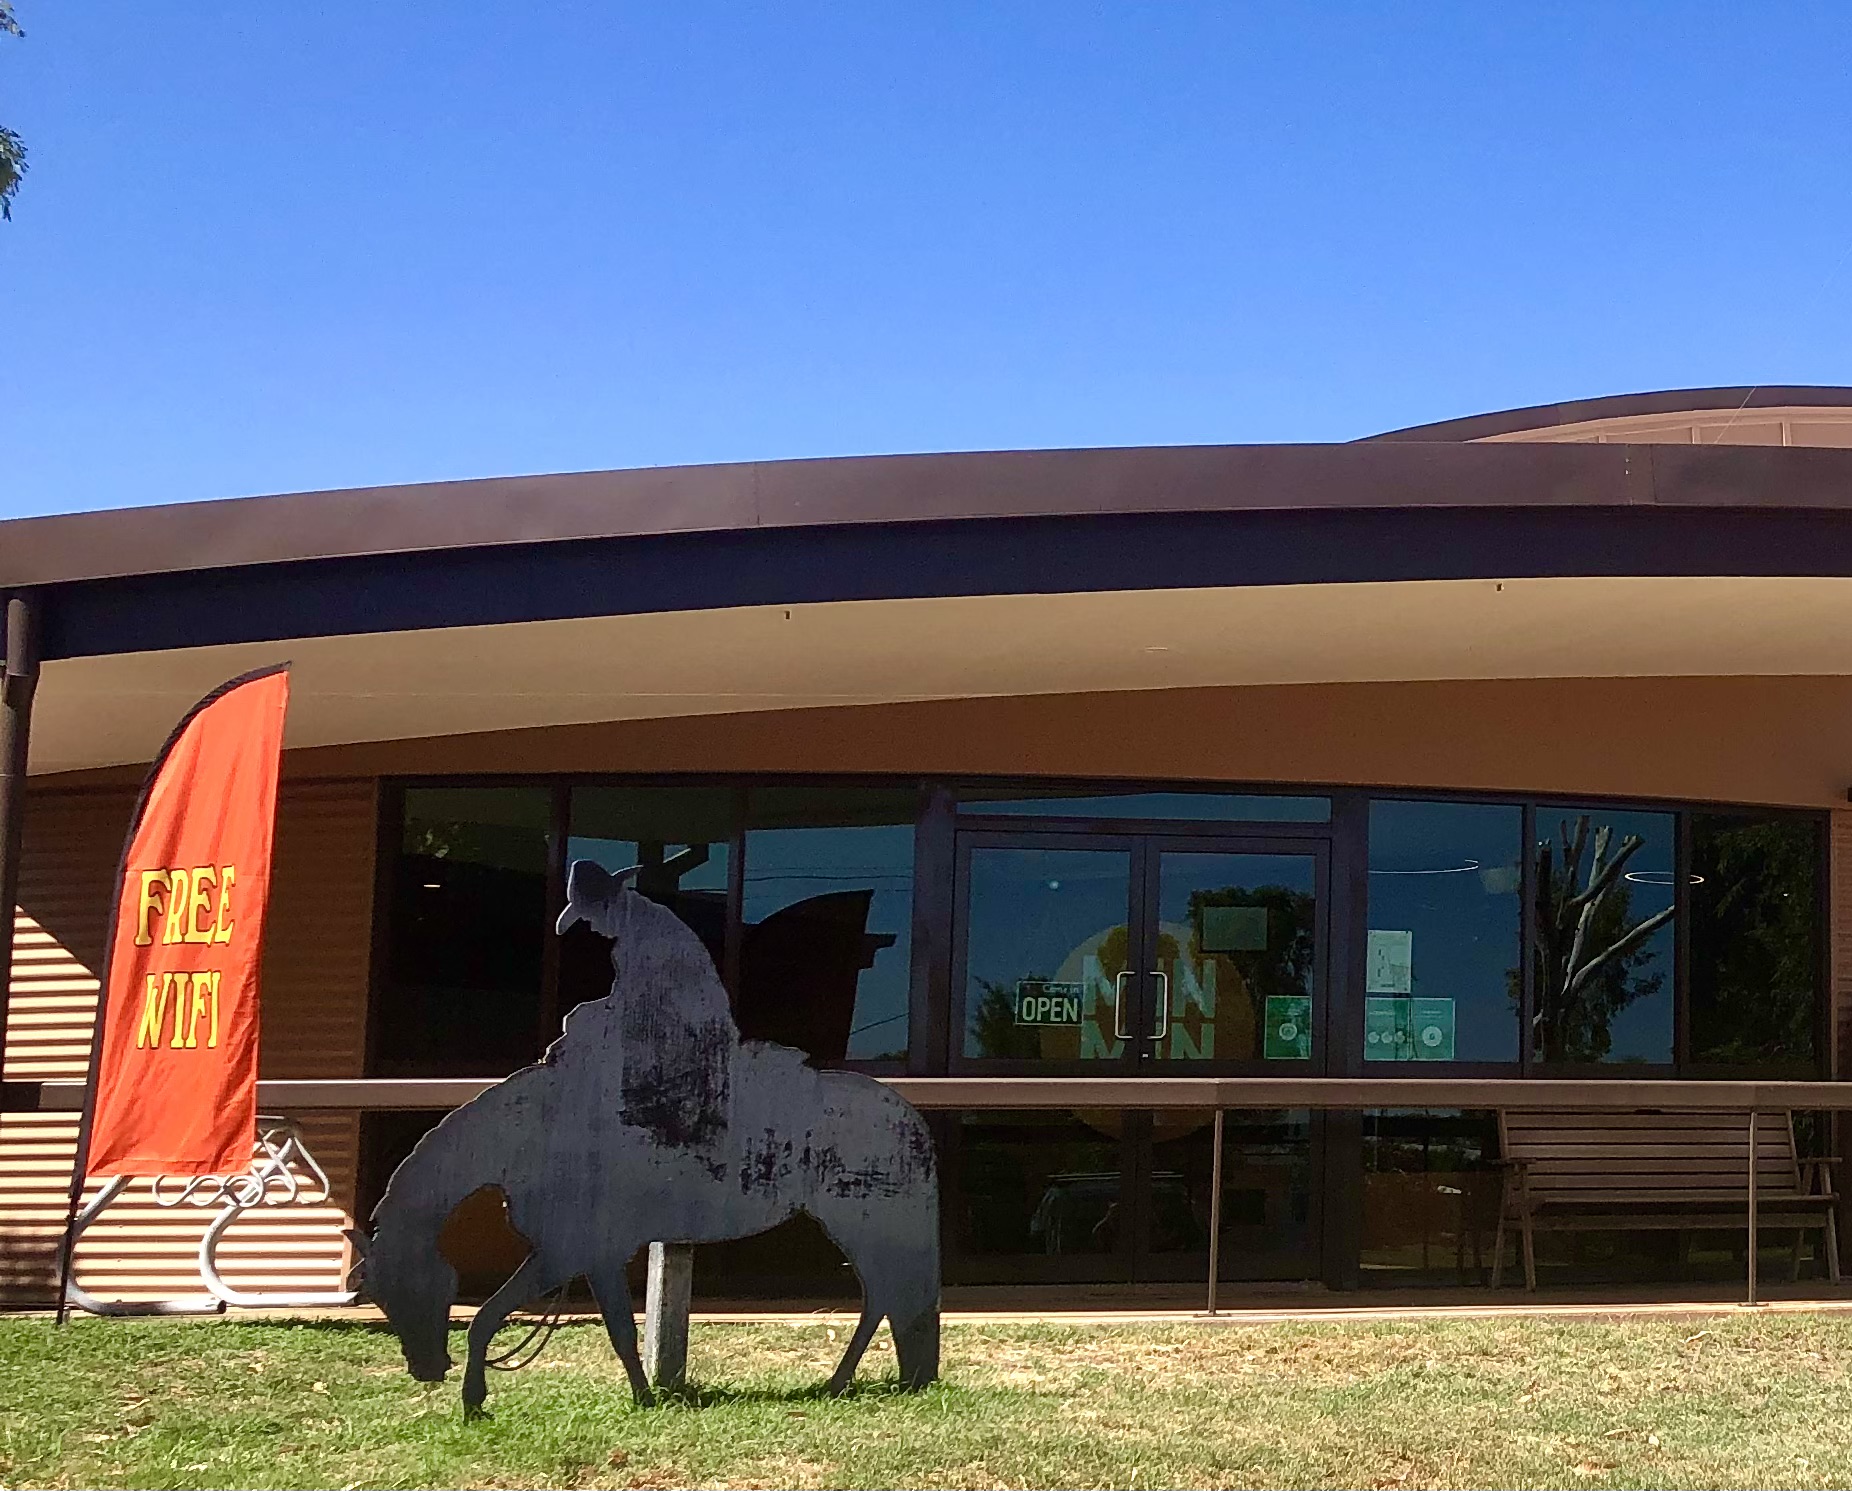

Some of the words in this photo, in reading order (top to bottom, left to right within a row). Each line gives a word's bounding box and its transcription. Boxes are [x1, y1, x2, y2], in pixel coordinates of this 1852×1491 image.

[133, 863, 237, 948] FREE
[136, 968, 222, 1050] WIFI
[1022, 996, 1079, 1022] OPEN
